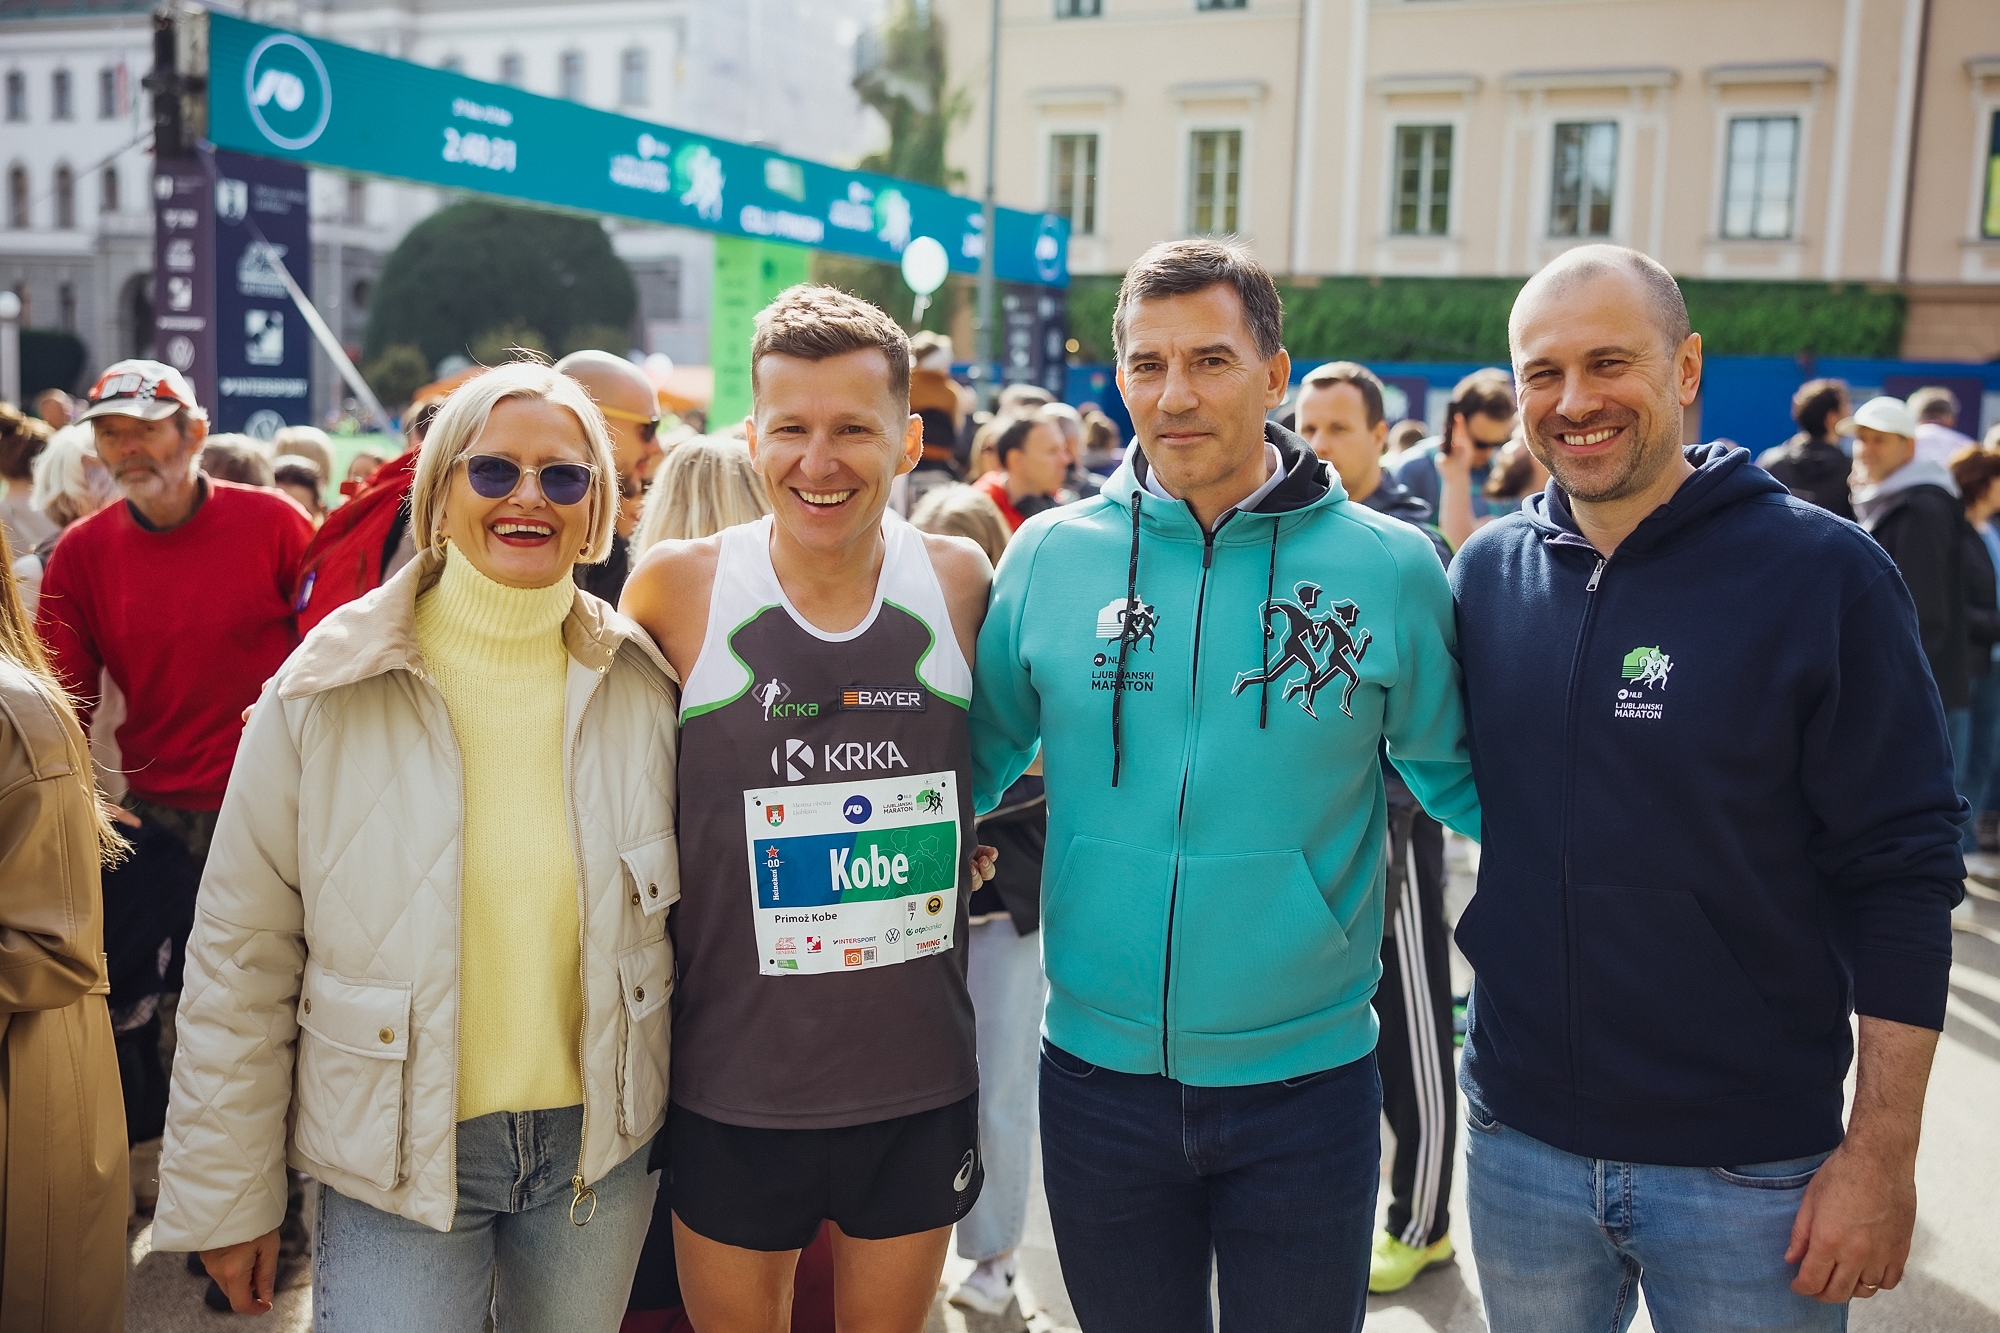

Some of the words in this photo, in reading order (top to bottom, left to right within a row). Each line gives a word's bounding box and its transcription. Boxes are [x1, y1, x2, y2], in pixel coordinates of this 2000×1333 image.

[1092, 671, 1154, 680] LJUBANSKI
[859, 691, 921, 706] BAYER
[1615, 702, 1663, 710] LJUBLJANSKI
[1614, 709, 1662, 719] MARATON
[825, 741, 909, 772] KRKA
[883, 806, 914, 814] MARATON
[829, 844, 909, 891] Kobe
[771, 868, 780, 901] Heineken
[774, 913, 810, 923] Primož
[811, 912, 838, 922] Kobe
[909, 912, 915, 921] 7
[838, 936, 877, 944] INTERSPORT
[916, 938, 941, 950] TIMING
